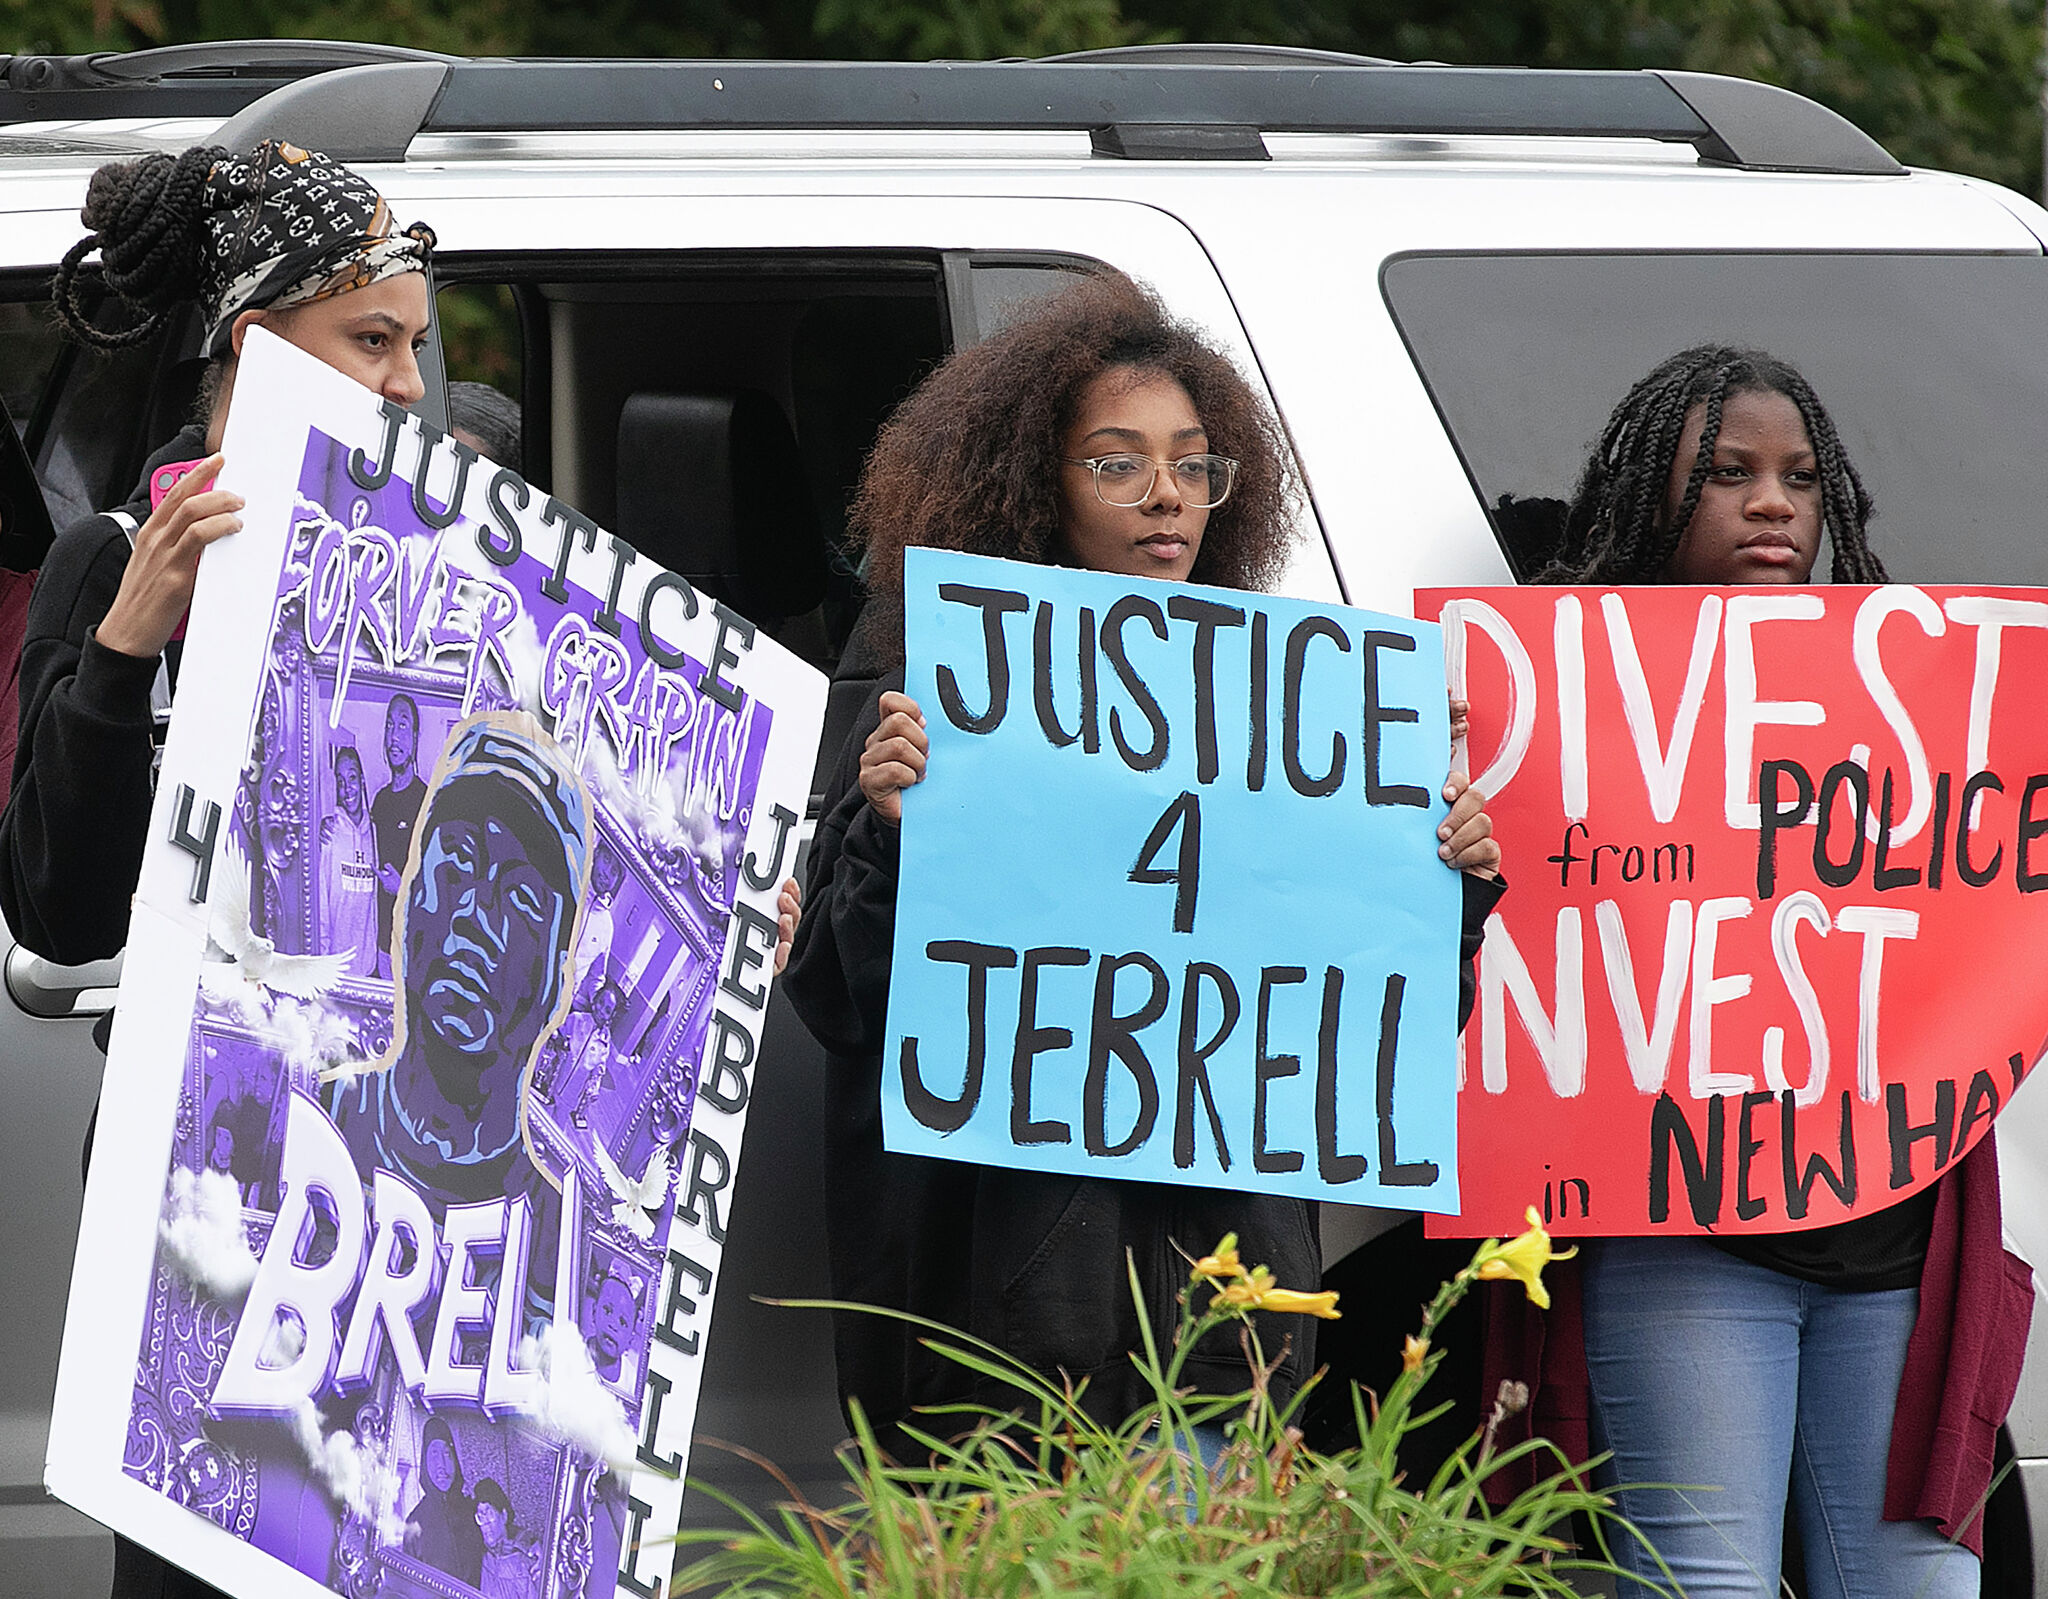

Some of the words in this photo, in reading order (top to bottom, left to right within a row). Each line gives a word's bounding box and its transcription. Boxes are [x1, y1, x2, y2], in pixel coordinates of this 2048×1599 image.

[348, 397, 757, 712] JUSTICE
[936, 583, 1430, 808] JUSTICE
[1439, 584, 2048, 847] DIVEST
[168, 782, 222, 904] 4
[1126, 791, 1200, 933] 4
[1546, 822, 1694, 886] from
[1757, 759, 2048, 899] POLICE
[900, 939, 1440, 1186] JEBRELL
[1456, 890, 1920, 1108] NVEST
[617, 802, 799, 1599] JEBRELL
[1544, 1165, 1589, 1224] in
[1648, 1089, 1858, 1232] NEW
